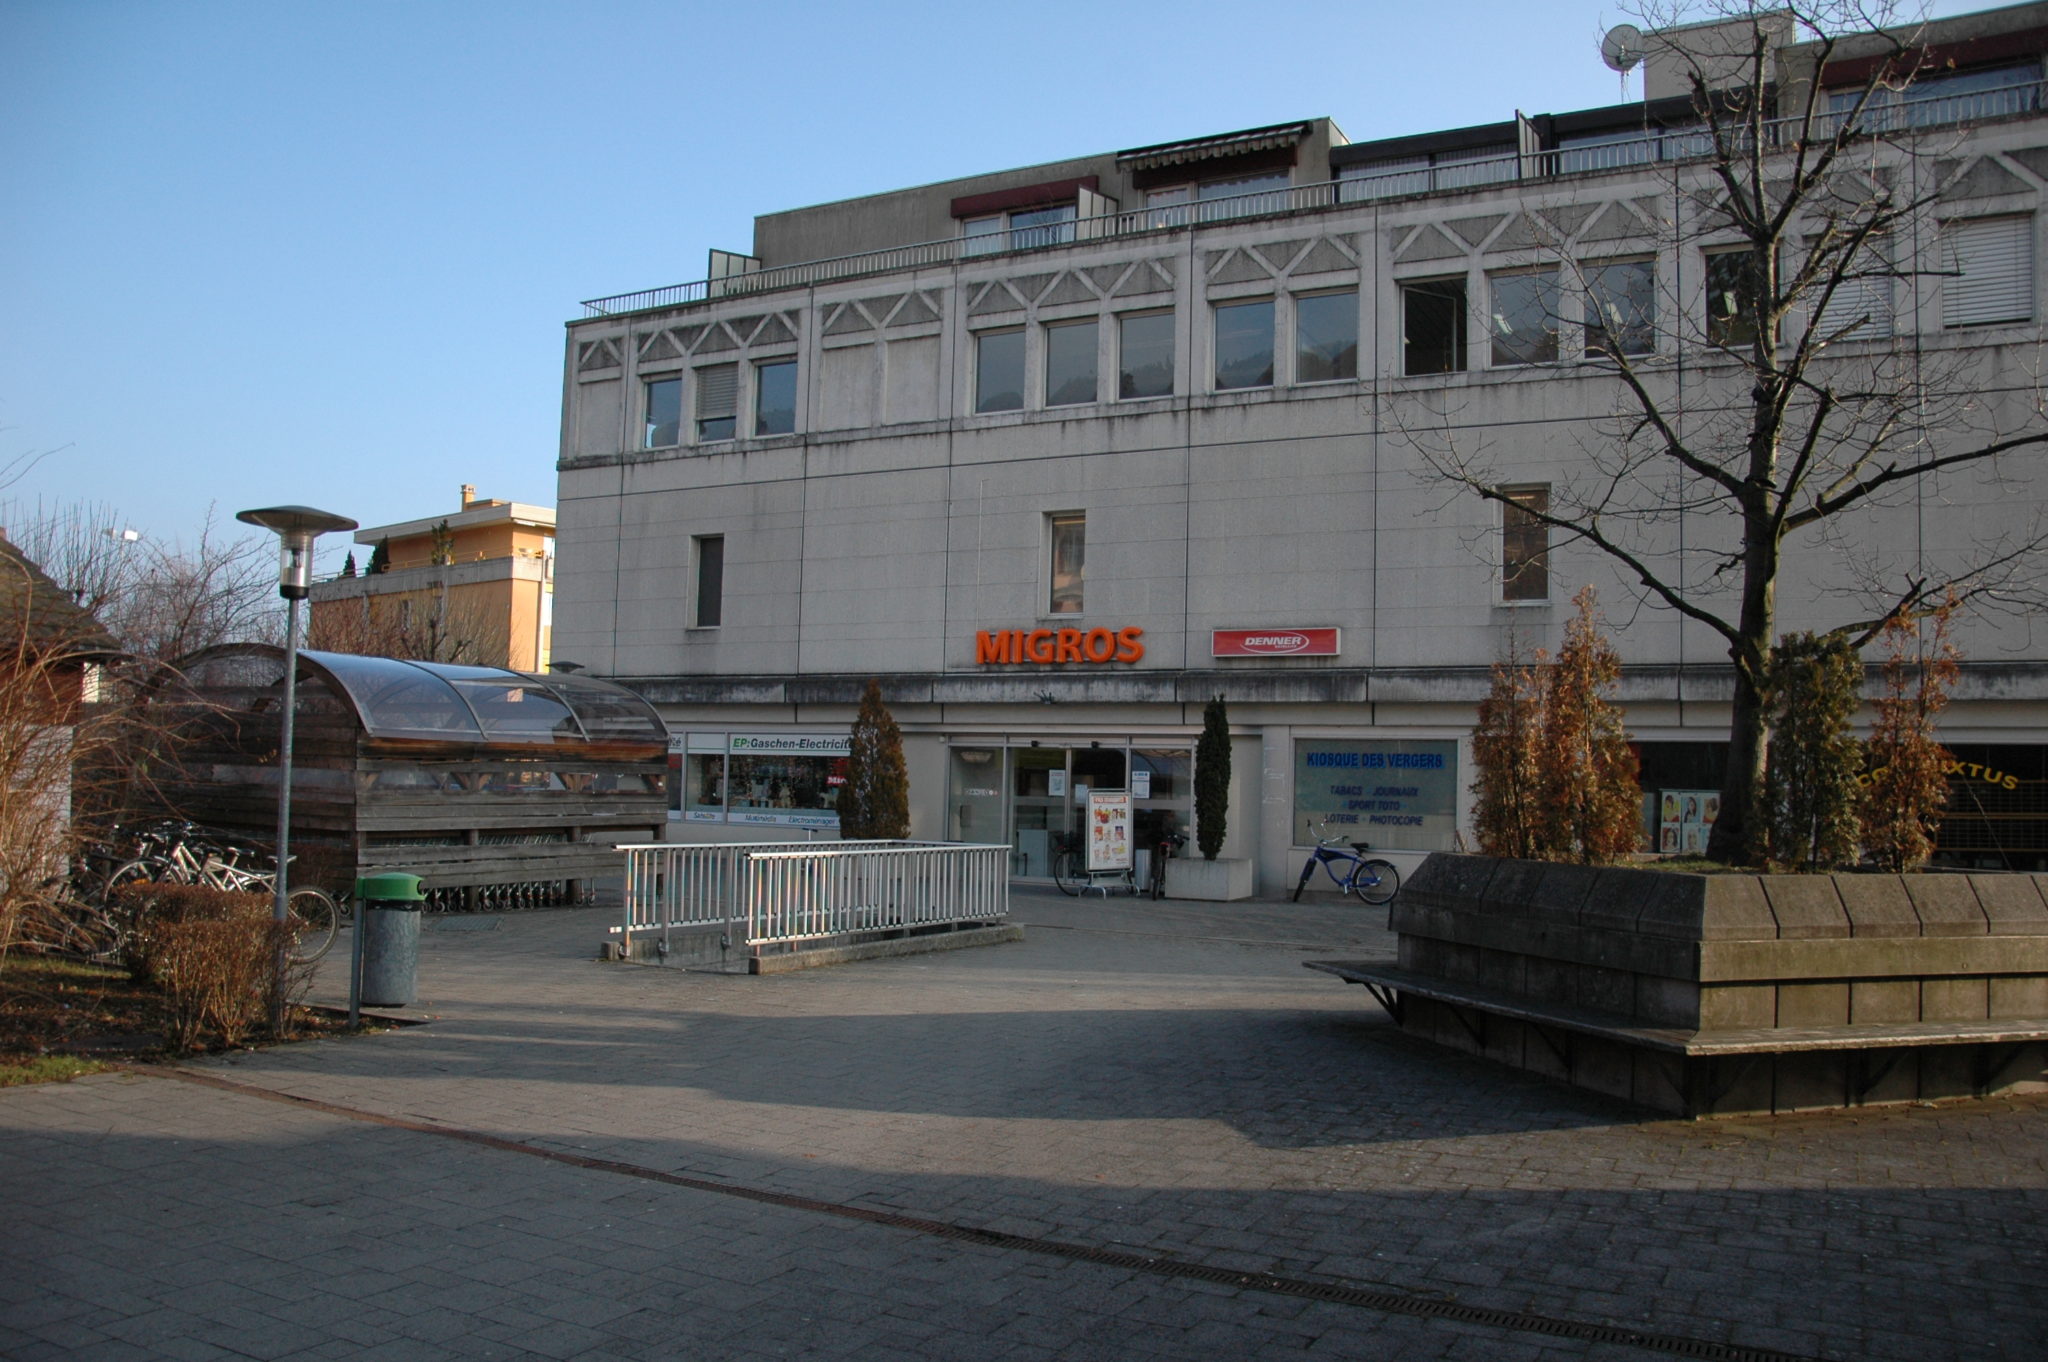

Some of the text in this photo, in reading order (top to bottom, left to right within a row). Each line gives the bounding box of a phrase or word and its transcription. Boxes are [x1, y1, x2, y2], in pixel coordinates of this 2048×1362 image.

[976, 626, 1145, 664] MIGROS
[1245, 636, 1302, 646] DENNER
[1307, 752, 1444, 769] KIOSQUE DES VERGERS
[1330, 785, 1419, 797] TABACS JOURNAUX
[1348, 800, 1401, 811] SPORT TOTO
[1325, 813, 1424, 826] LOTERIE PHOTOCOPIE
